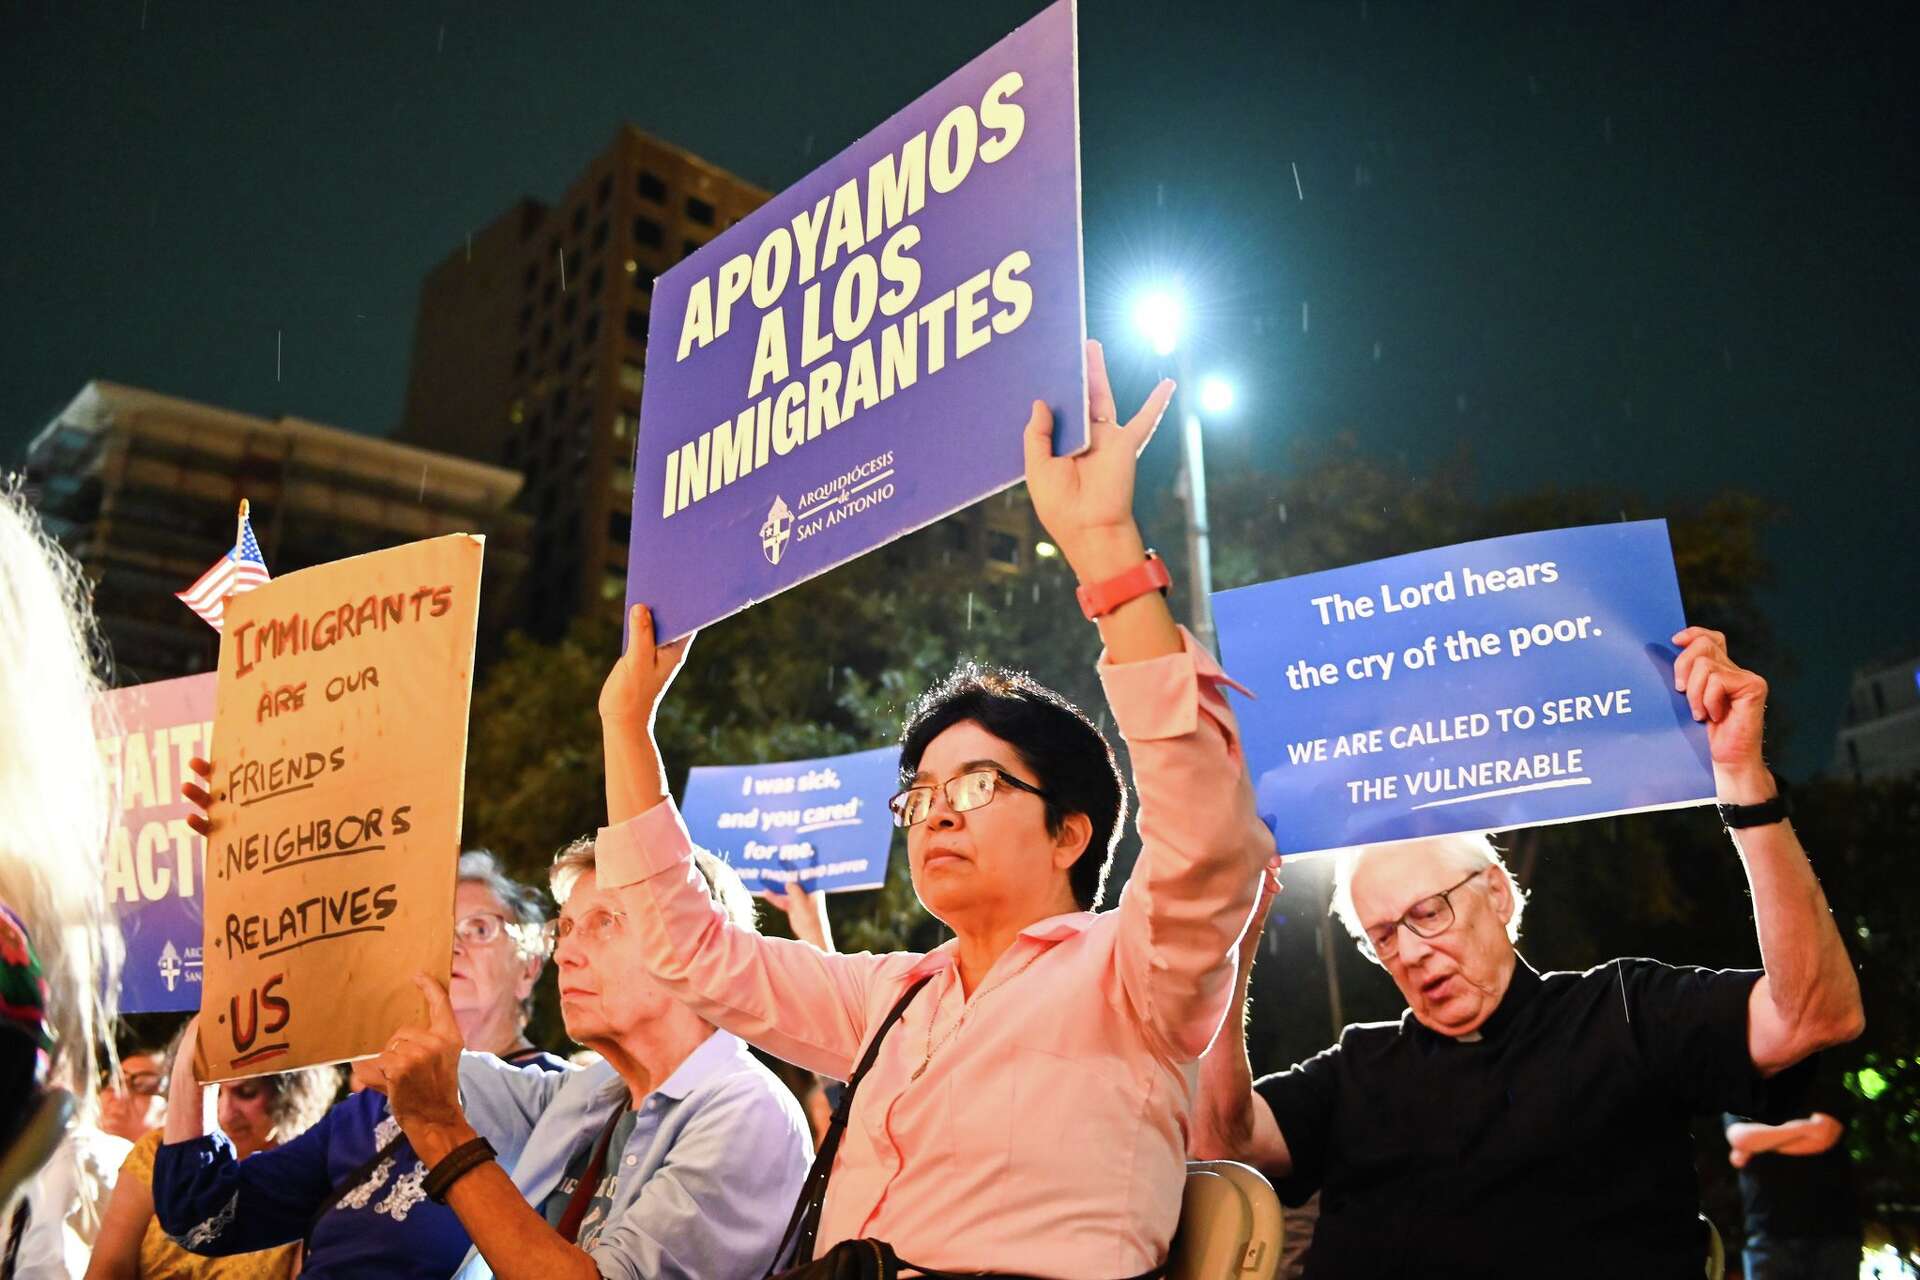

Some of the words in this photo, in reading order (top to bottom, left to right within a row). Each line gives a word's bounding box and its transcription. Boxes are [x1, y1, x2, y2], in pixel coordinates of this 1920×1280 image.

[676, 71, 1025, 362] APOYAMOS
[748, 306, 789, 399] A
[801, 224, 921, 367] LOS
[663, 250, 1033, 519] INMIGRANTES
[797, 518, 823, 541] SAN
[826, 483, 895, 528] ANTONIO
[798, 450, 894, 510] ARQUIDIÓCESIS
[838, 488, 850, 504] de
[1311, 594, 1375, 625] The
[1380, 571, 1456, 613] Lord
[1463, 561, 1559, 597] hears
[233, 585, 454, 679] IMMIGRANTS
[1285, 660, 1339, 690] the
[1345, 652, 1394, 680] cry
[1403, 636, 1437, 670] of
[1444, 630, 1501, 662] the
[1509, 615, 1602, 656] poor.
[257, 681, 307, 723] ARE
[326, 666, 379, 701] OUR
[1287, 739, 1327, 765] WE
[1333, 730, 1383, 758] ARE
[1390, 714, 1490, 749] CALLED
[1496, 705, 1535, 733] TO
[1542, 689, 1632, 726] SERVE
[229, 746, 345, 803] FRIENDS
[1347, 776, 1398, 804] THE
[1404, 748, 1584, 795] VULNERABLE
[226, 806, 411, 880] NEIGHBORS
[717, 808, 759, 829] and
[762, 810, 800, 832] you
[803, 797, 858, 824] cared
[107, 819, 208, 903] ACT
[225, 884, 397, 960] RELATIVES
[231, 973, 290, 1053] US
